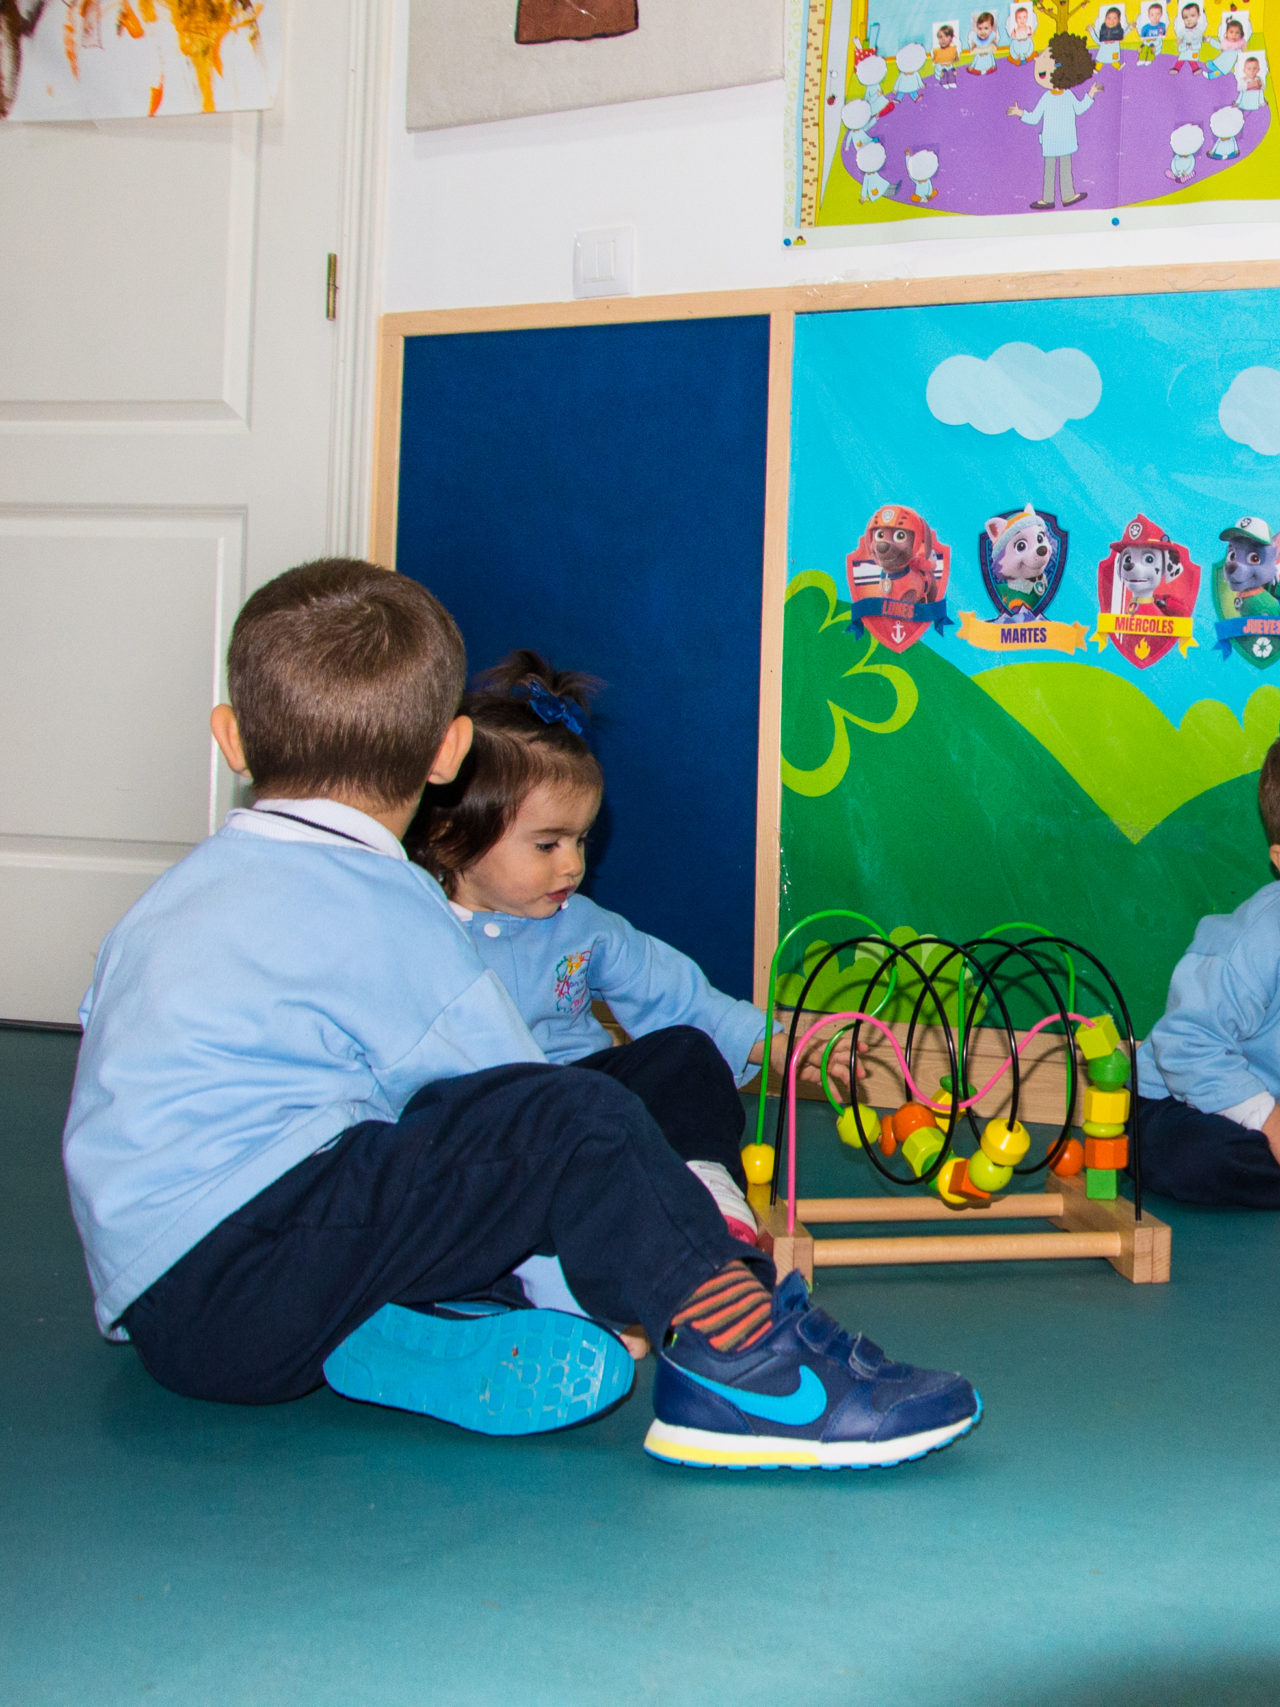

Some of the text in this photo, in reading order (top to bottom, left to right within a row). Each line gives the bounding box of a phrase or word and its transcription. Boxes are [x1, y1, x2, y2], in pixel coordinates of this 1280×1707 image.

[882, 599, 915, 618] LUNES
[1115, 615, 1175, 634] MIÉRCOLES
[1000, 627, 1047, 644] MARTES
